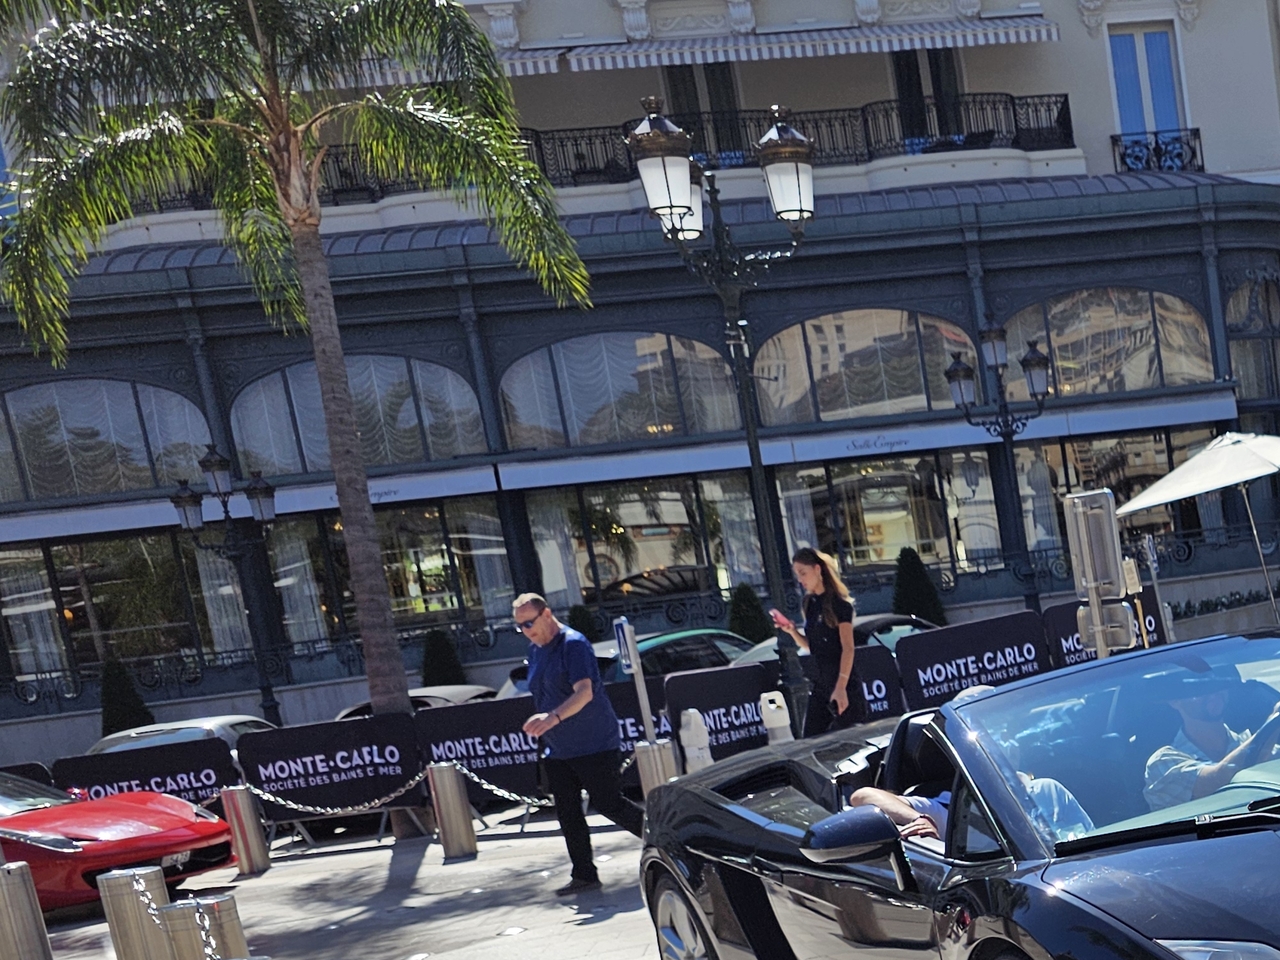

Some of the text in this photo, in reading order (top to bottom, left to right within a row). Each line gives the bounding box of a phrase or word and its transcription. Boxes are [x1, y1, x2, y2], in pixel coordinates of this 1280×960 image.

[923, 662, 1039, 698] SOCIÉTÉ DES BAINS DE MER
[870, 701, 889, 713] MER
[471, 760, 488, 769] DES
[489, 755, 513, 767] BAINS
[515, 754, 526, 764] DE
[263, 777, 307, 793] SOCIÉTÉ
[309, 774, 330, 786] DES
[333, 768, 364, 783] BAINS
[379, 765, 402, 776] MER
